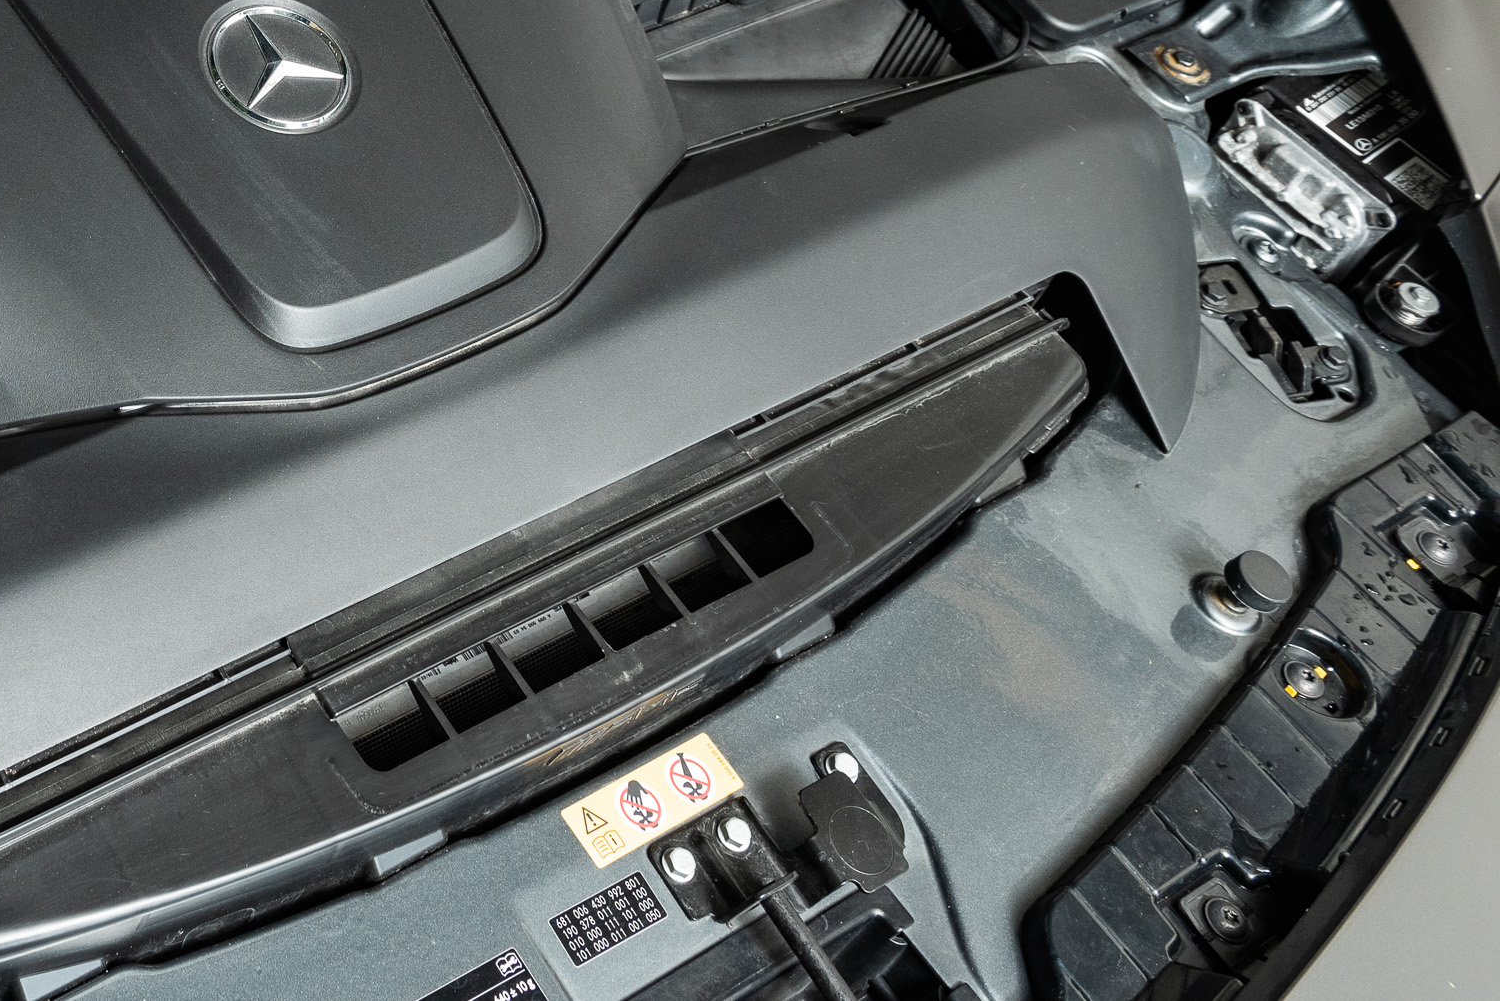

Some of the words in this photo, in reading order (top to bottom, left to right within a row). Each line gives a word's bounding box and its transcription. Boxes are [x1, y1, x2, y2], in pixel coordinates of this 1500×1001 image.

[526, 620, 536, 628] 500
[555, 914, 571, 929] 681
[572, 904, 589, 919] 006
[591, 894, 606, 909] 430
[607, 885, 624, 900] 992
[624, 876, 640, 890] 801
[562, 924, 578, 940] 190
[579, 915, 596, 930] 378
[596, 905, 613, 920] 011
[614, 896, 630, 911] 001
[632, 886, 648, 901] 100
[568, 935, 585, 951] 010
[586, 926, 603, 941] 000
[604, 916, 620, 931] 111
[621, 906, 637, 921] 101
[638, 897, 654, 912] 000
[576, 947, 592, 962] 101
[593, 937, 610, 952] 000
[610, 927, 627, 942] 011
[627, 917, 644, 932] 001
[645, 908, 661, 923] 050
